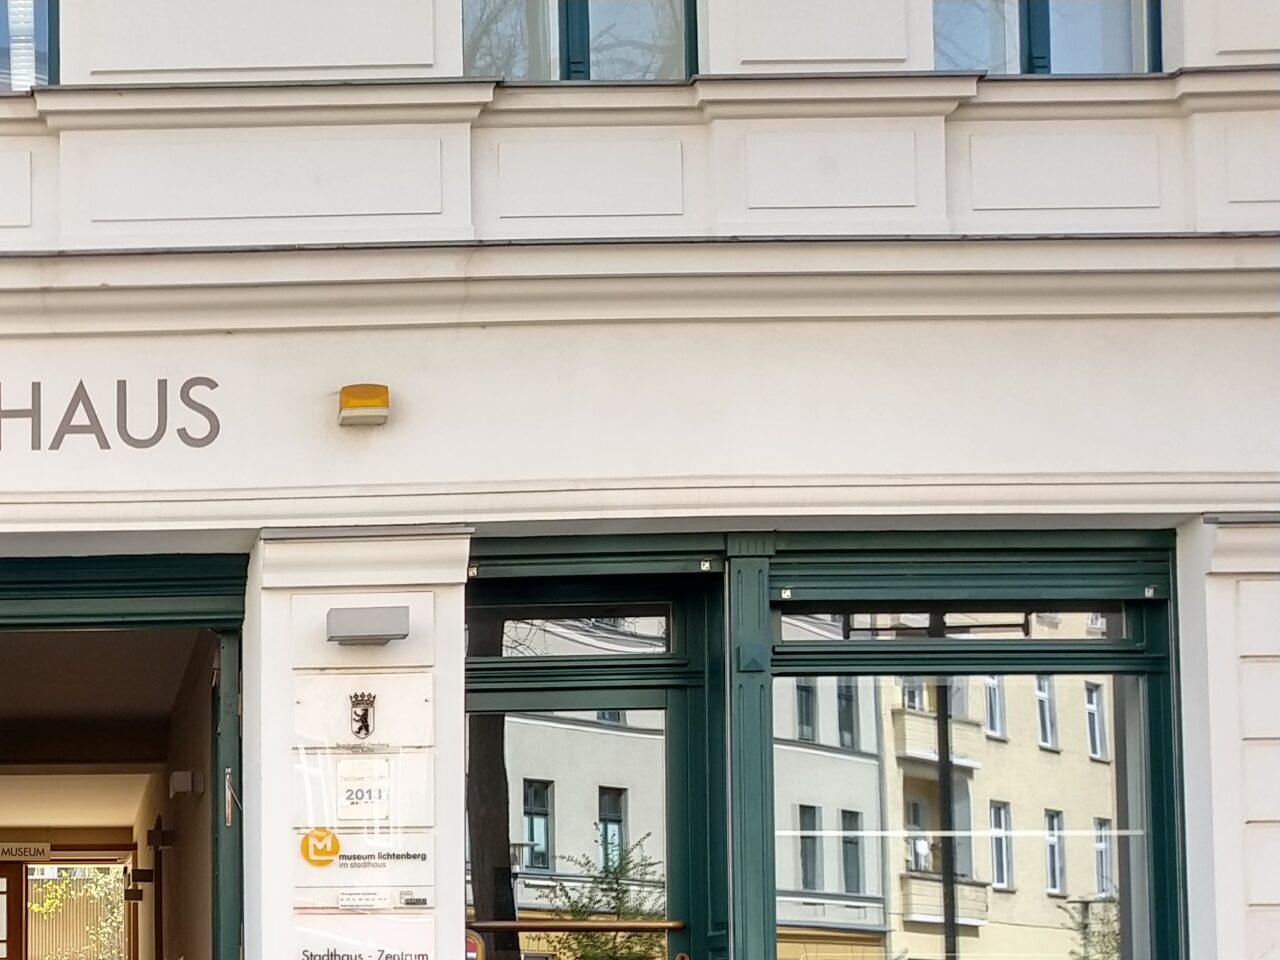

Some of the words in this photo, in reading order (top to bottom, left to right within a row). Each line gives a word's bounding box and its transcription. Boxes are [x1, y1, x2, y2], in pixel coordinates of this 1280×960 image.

[0, 847, 46, 857] MUSEUM
[338, 853, 376, 861] museum
[377, 851, 427, 862] lichtenberg
[338, 861, 349, 869] im
[350, 860, 387, 869] stadthaus
